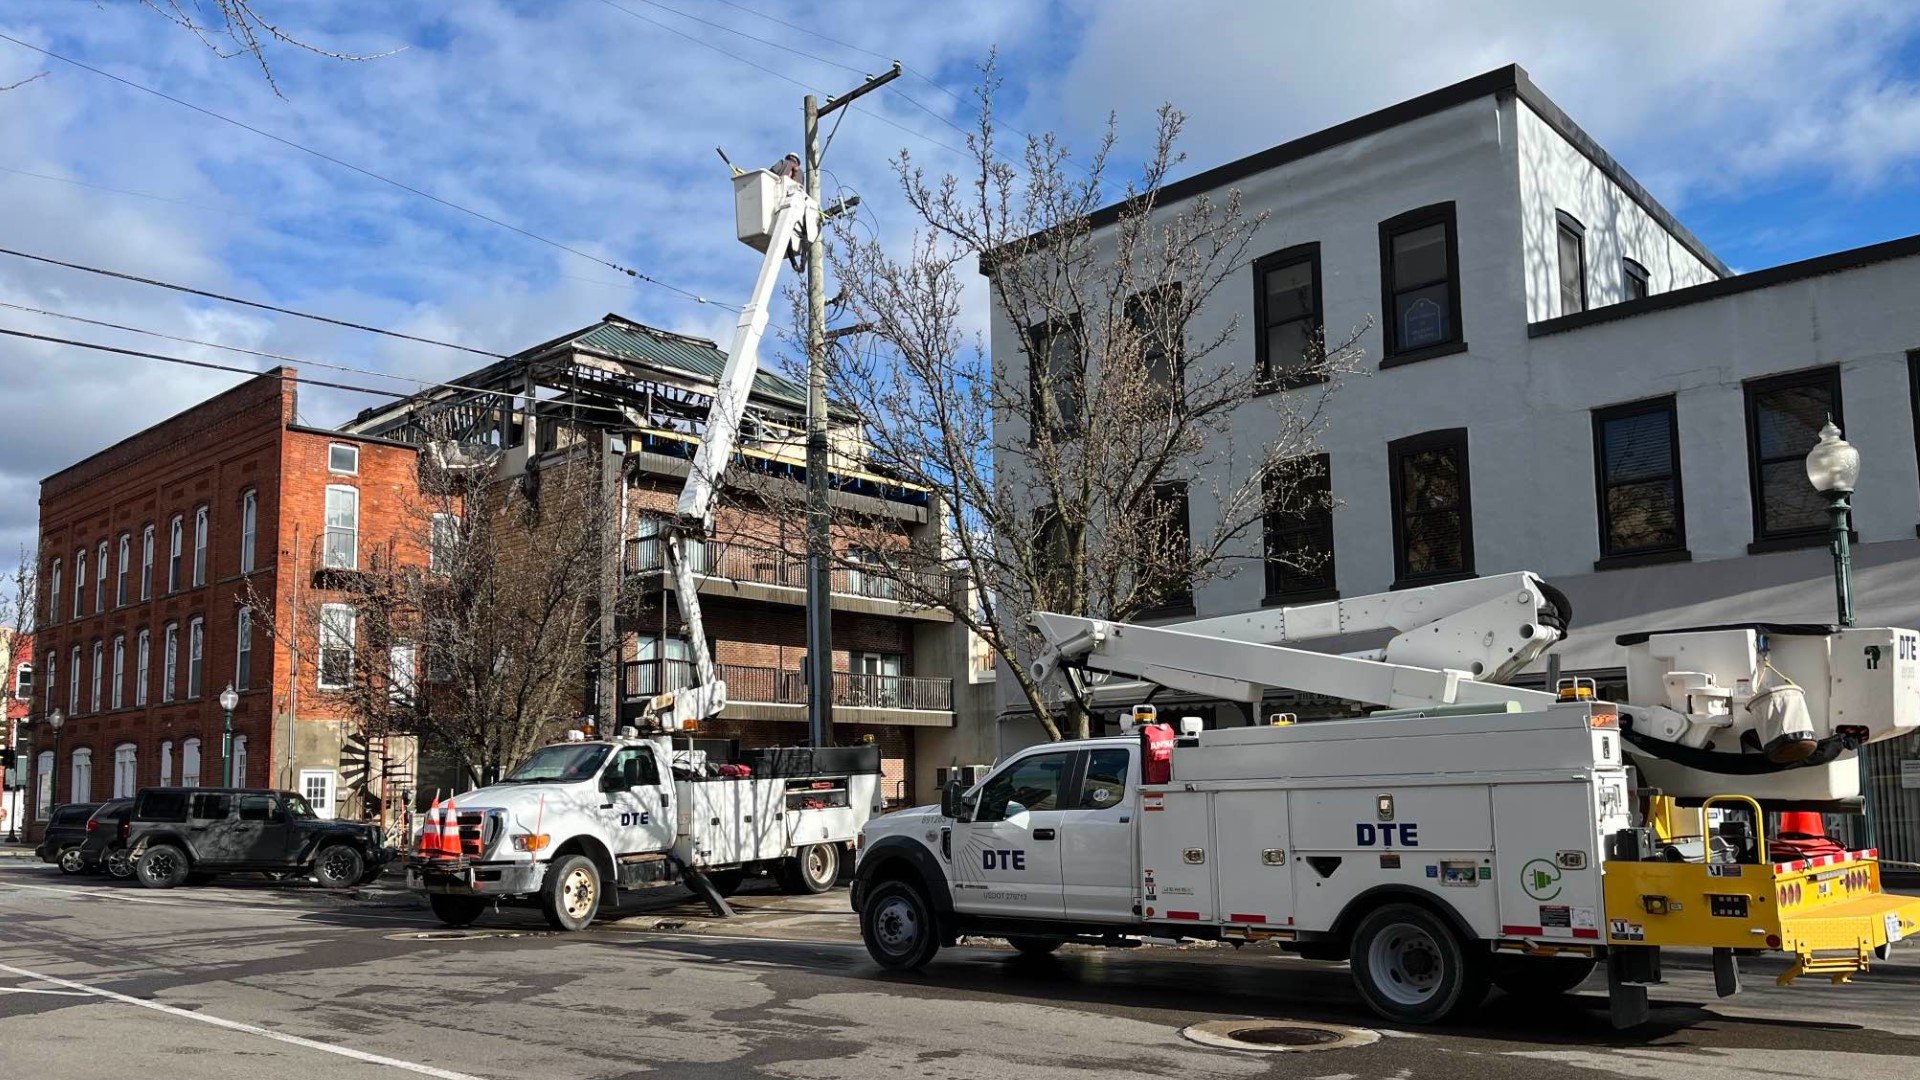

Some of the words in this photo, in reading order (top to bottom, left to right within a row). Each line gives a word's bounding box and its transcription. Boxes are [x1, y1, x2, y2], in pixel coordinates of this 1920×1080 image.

[1899, 634, 1917, 660] DTE
[621, 811, 649, 826] DTE
[1356, 823, 1419, 846] DTE
[982, 849, 1026, 870] DTE
[983, 892, 1005, 900] USDOT
